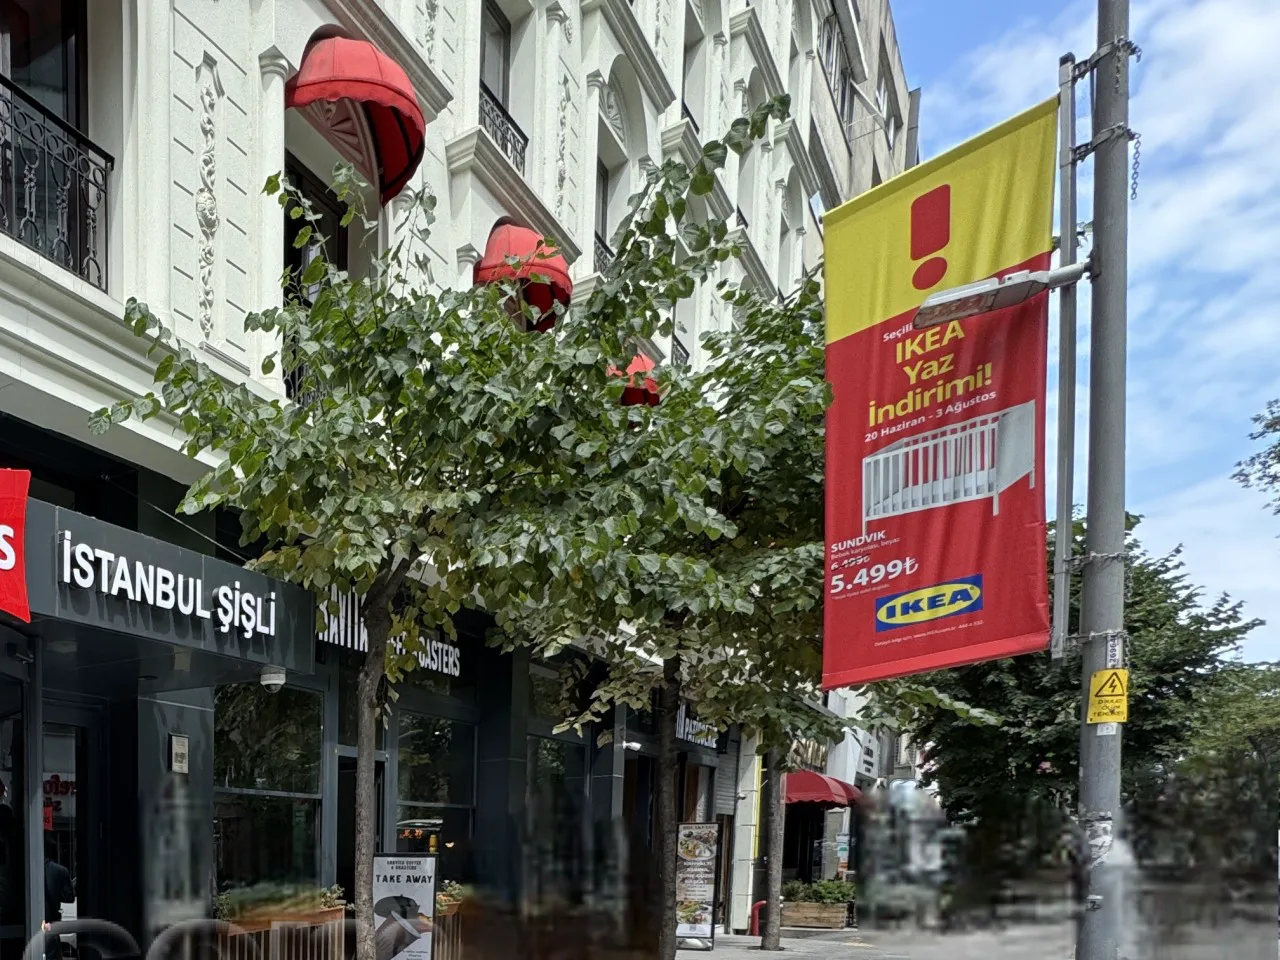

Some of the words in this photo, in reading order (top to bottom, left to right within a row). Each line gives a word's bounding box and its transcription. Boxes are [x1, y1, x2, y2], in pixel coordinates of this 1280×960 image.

[883, 323, 913, 342] Seçili
[895, 320, 965, 364] IKEA
[903, 353, 955, 386] Yaz
[868, 362, 993, 428] İndirimi!
[865, 432, 878, 444] 20
[880, 415, 926, 439] Haziran
[935, 409, 943, 419] 3
[945, 390, 997, 414] Ağustos
[830, 530, 886, 553] SUNDVIK
[62, 529, 211, 620] İSTANBUL
[217, 580, 277, 639] ŞİŞLİ
[886, 587, 974, 621] IKEA
[412, 635, 460, 677] OASTERS
[376, 874, 402, 884] TAKE
[405, 874, 433, 884] AWAY
